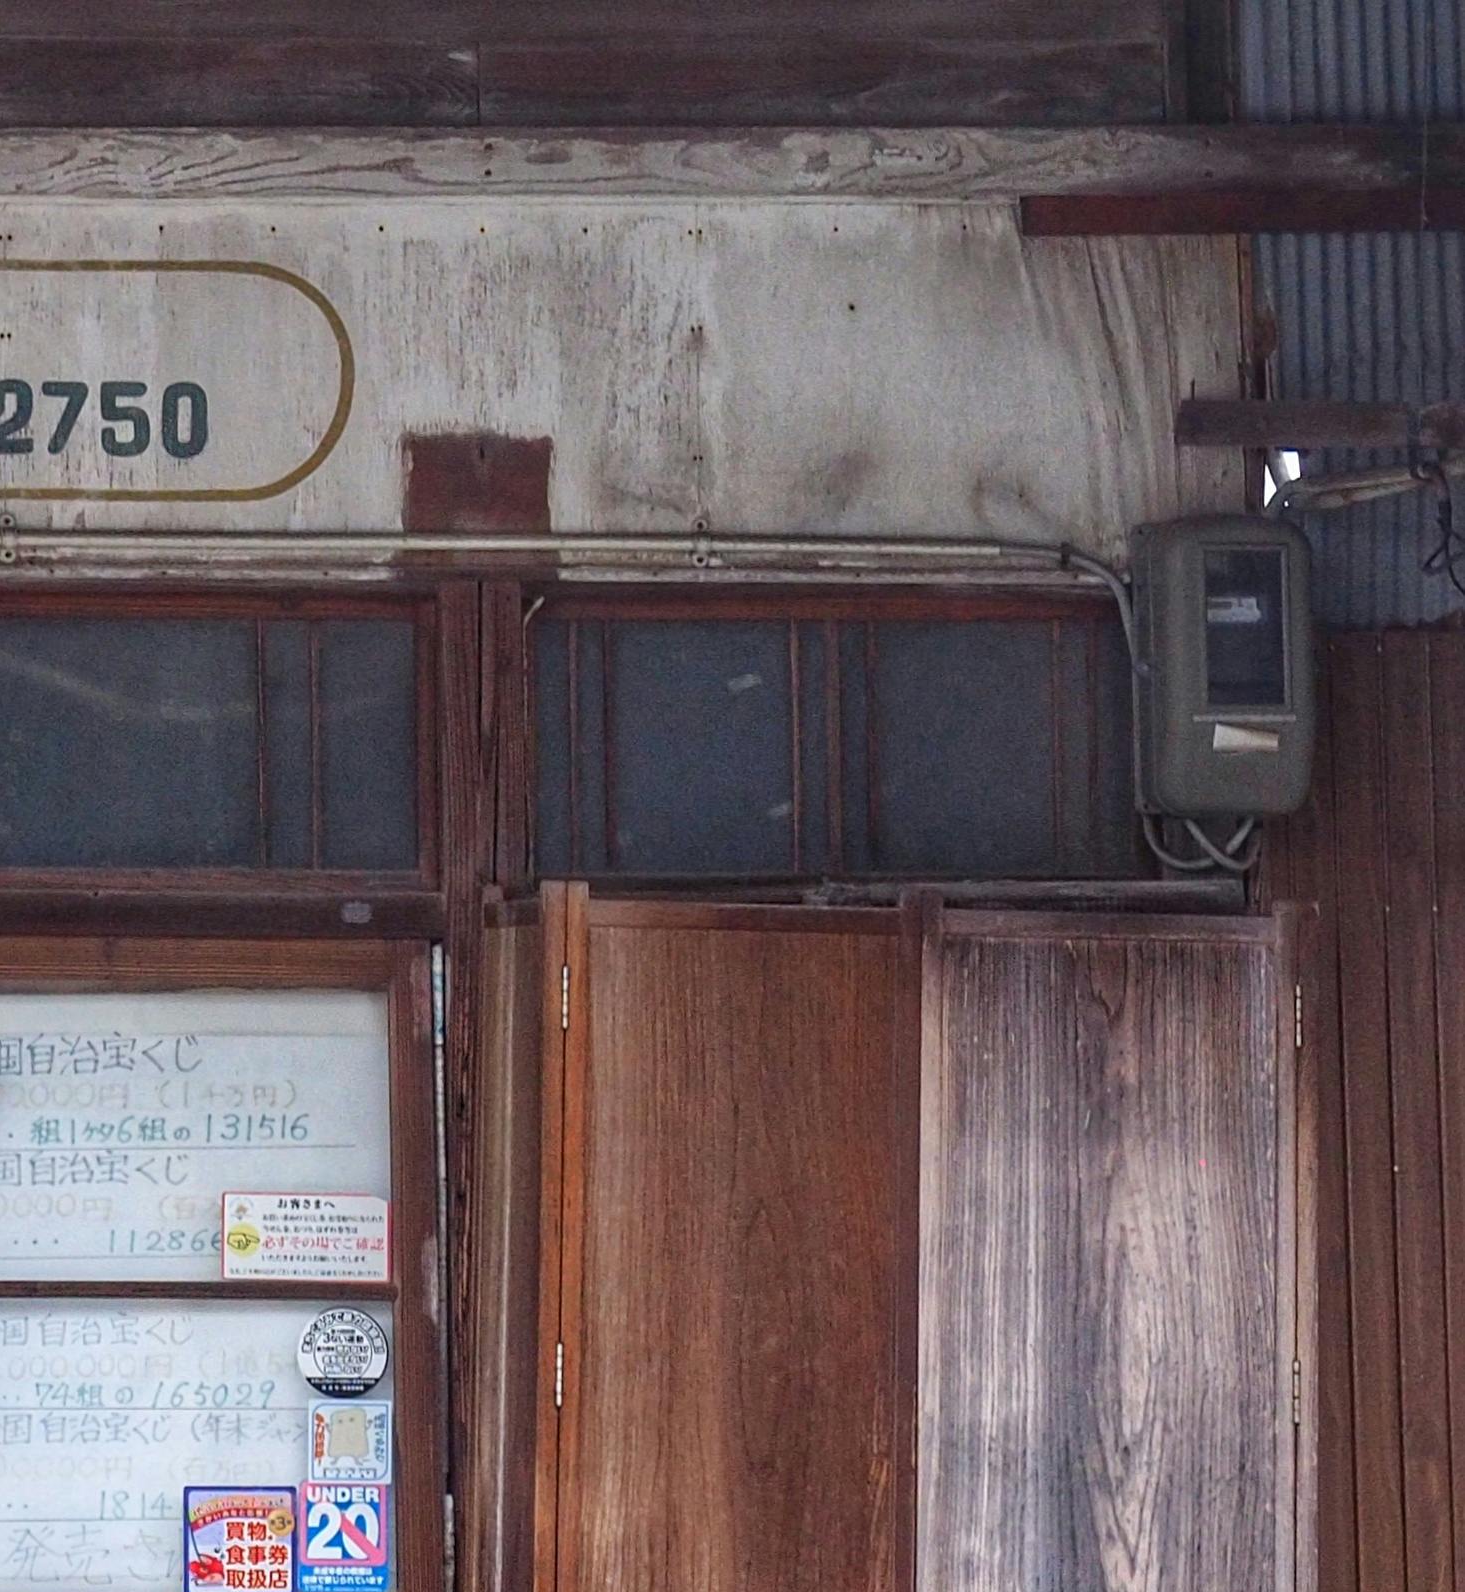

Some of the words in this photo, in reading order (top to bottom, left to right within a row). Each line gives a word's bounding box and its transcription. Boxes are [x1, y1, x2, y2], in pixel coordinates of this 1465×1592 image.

[306, 1486, 380, 1503] UNDER
[306, 1502, 380, 1560] 20
[226, 1545, 289, 1565] 食事券
[226, 1569, 289, 1590] 取扱店
